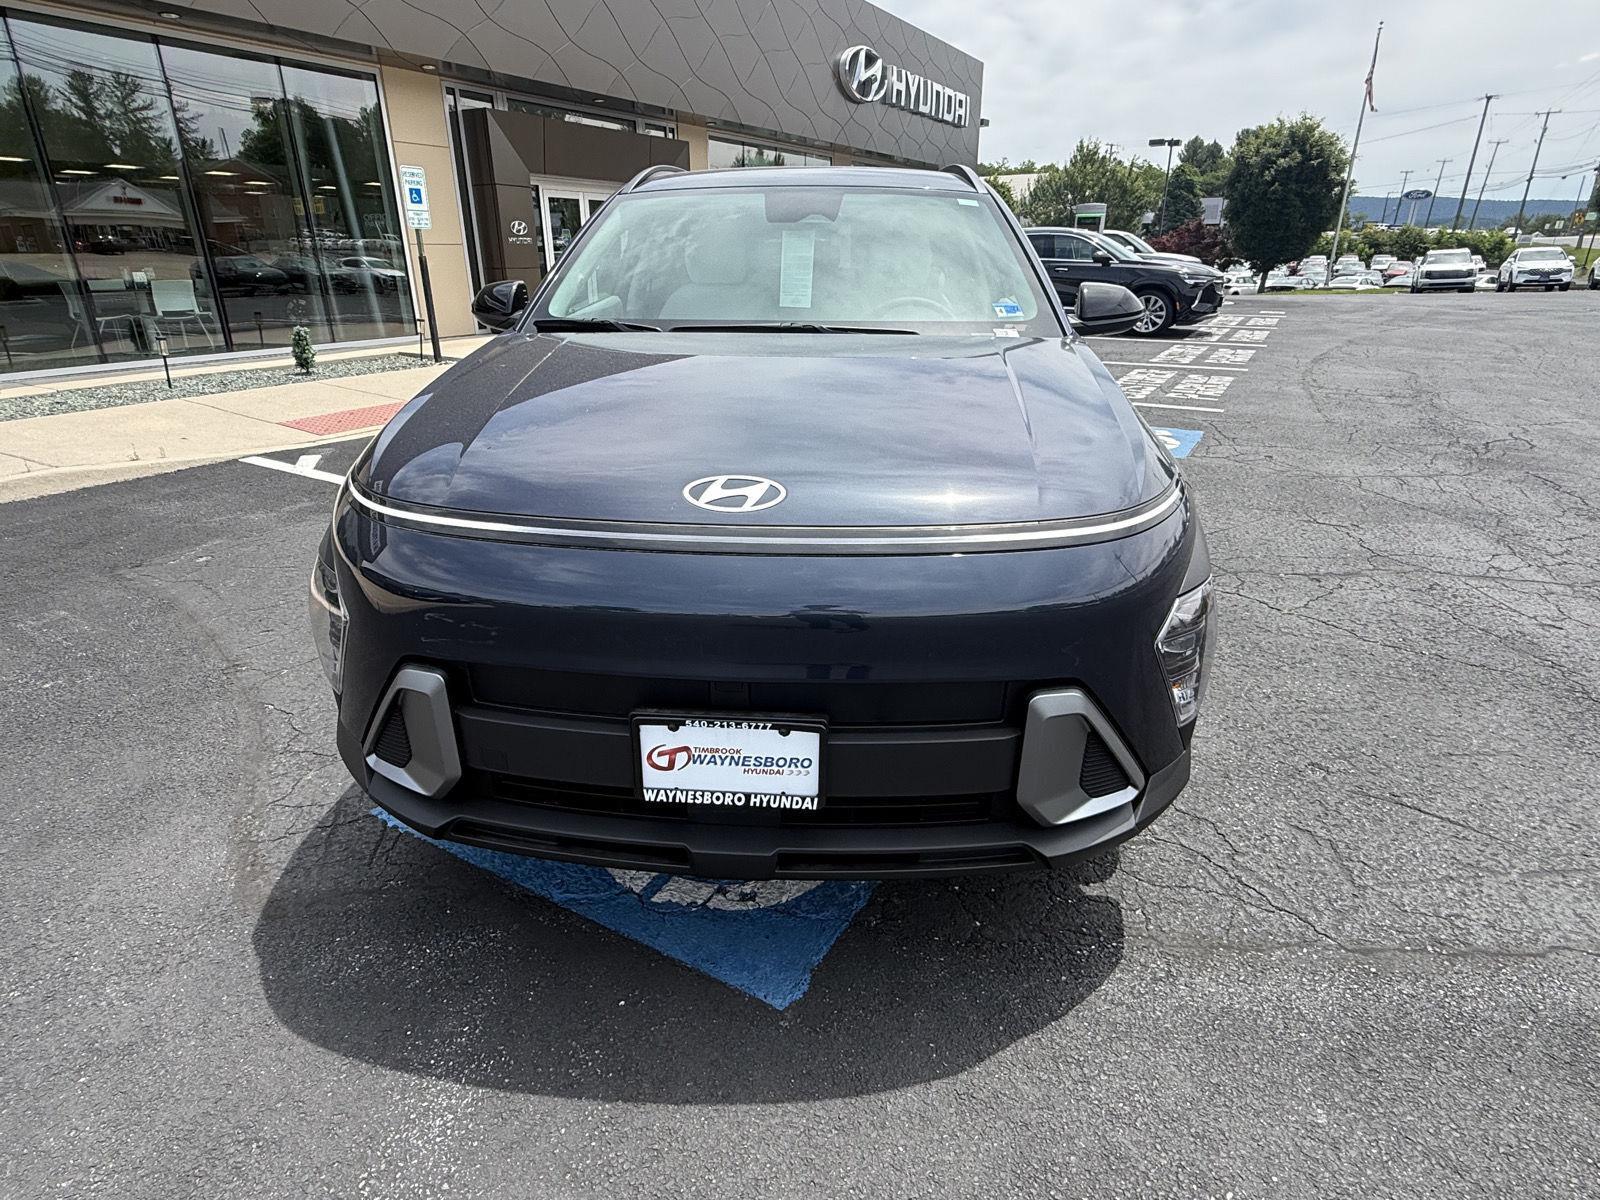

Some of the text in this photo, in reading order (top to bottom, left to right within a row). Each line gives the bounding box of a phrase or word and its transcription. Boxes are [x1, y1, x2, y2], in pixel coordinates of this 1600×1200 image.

[887, 65, 970, 127] HYUNDAI
[685, 720, 772, 731] 540-213-6777
[693, 747, 743, 755] TIMBROOK
[692, 754, 812, 769] WAYNESBORO
[743, 768, 784, 776] HYUNDAI
[643, 789, 818, 811] WAYNESBORO HYUNDAI
